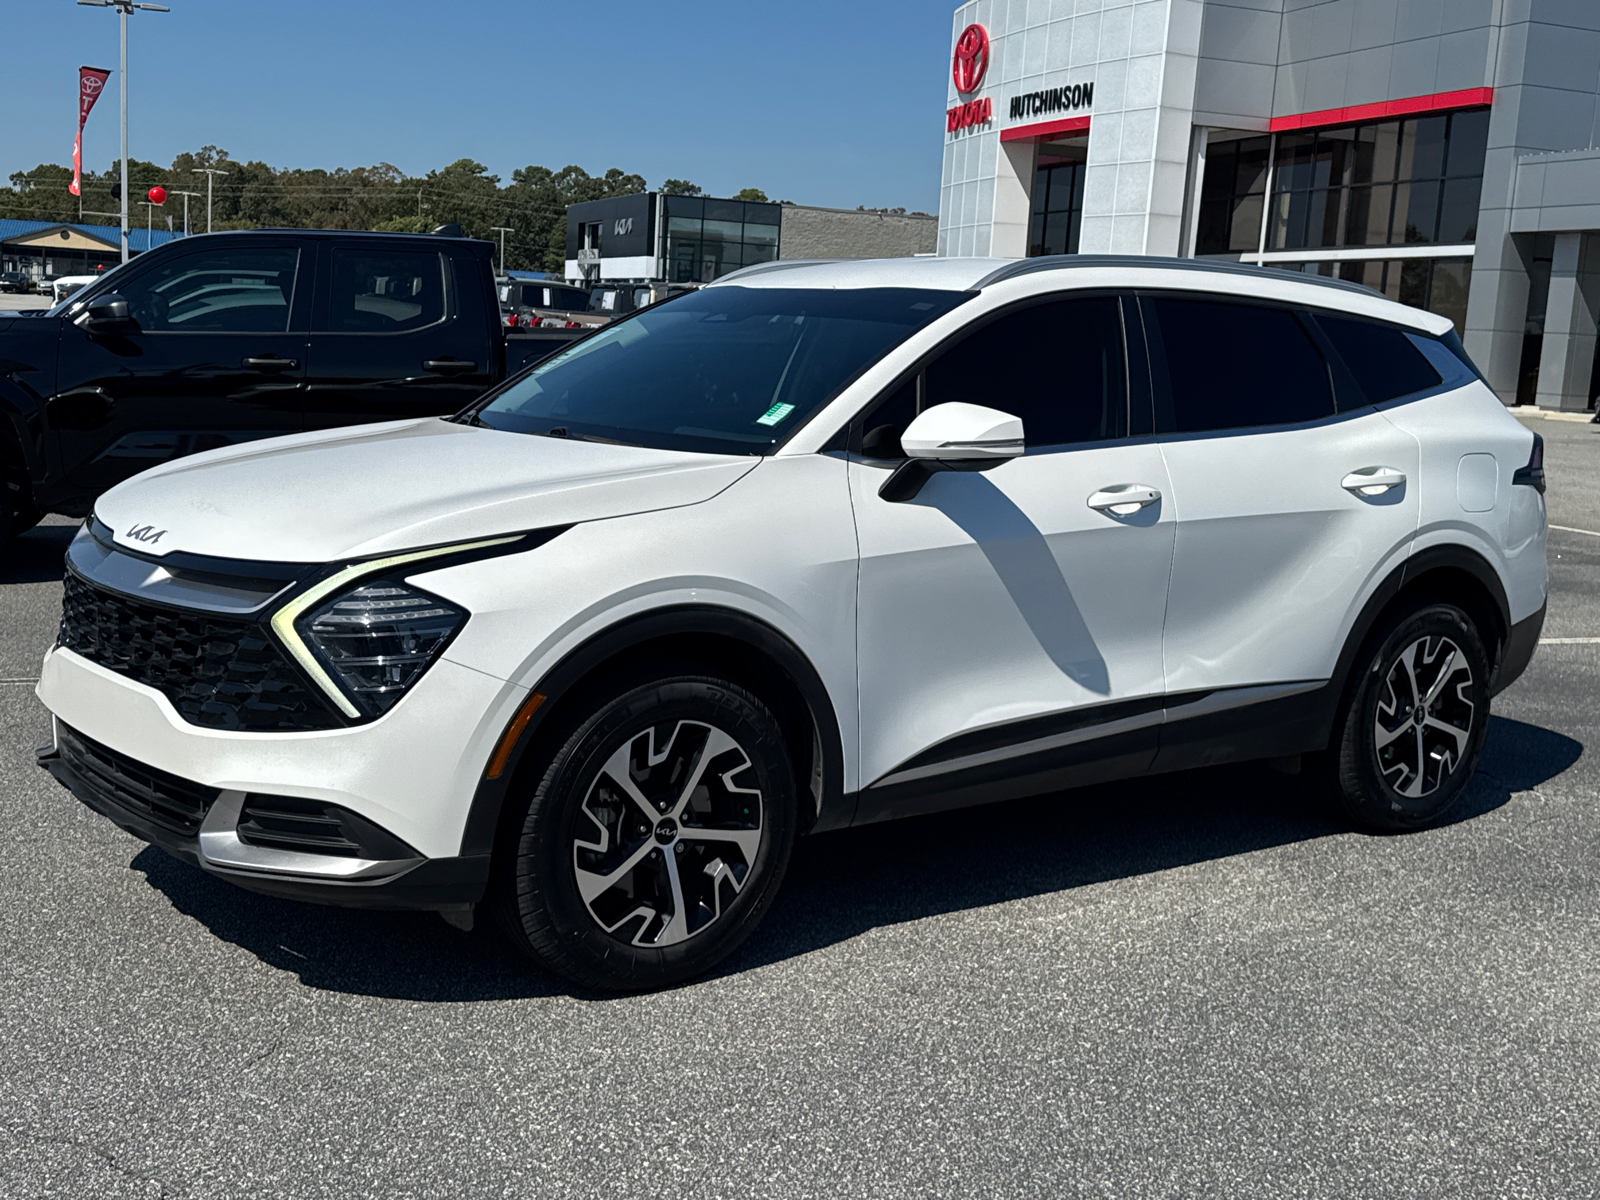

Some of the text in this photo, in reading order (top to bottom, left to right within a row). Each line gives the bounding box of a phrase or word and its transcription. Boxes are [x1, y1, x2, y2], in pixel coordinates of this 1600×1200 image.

[947, 97, 991, 133] TOYOTA
[1009, 82, 1094, 121] HUTCHINSON
[126, 523, 168, 545] KIA
